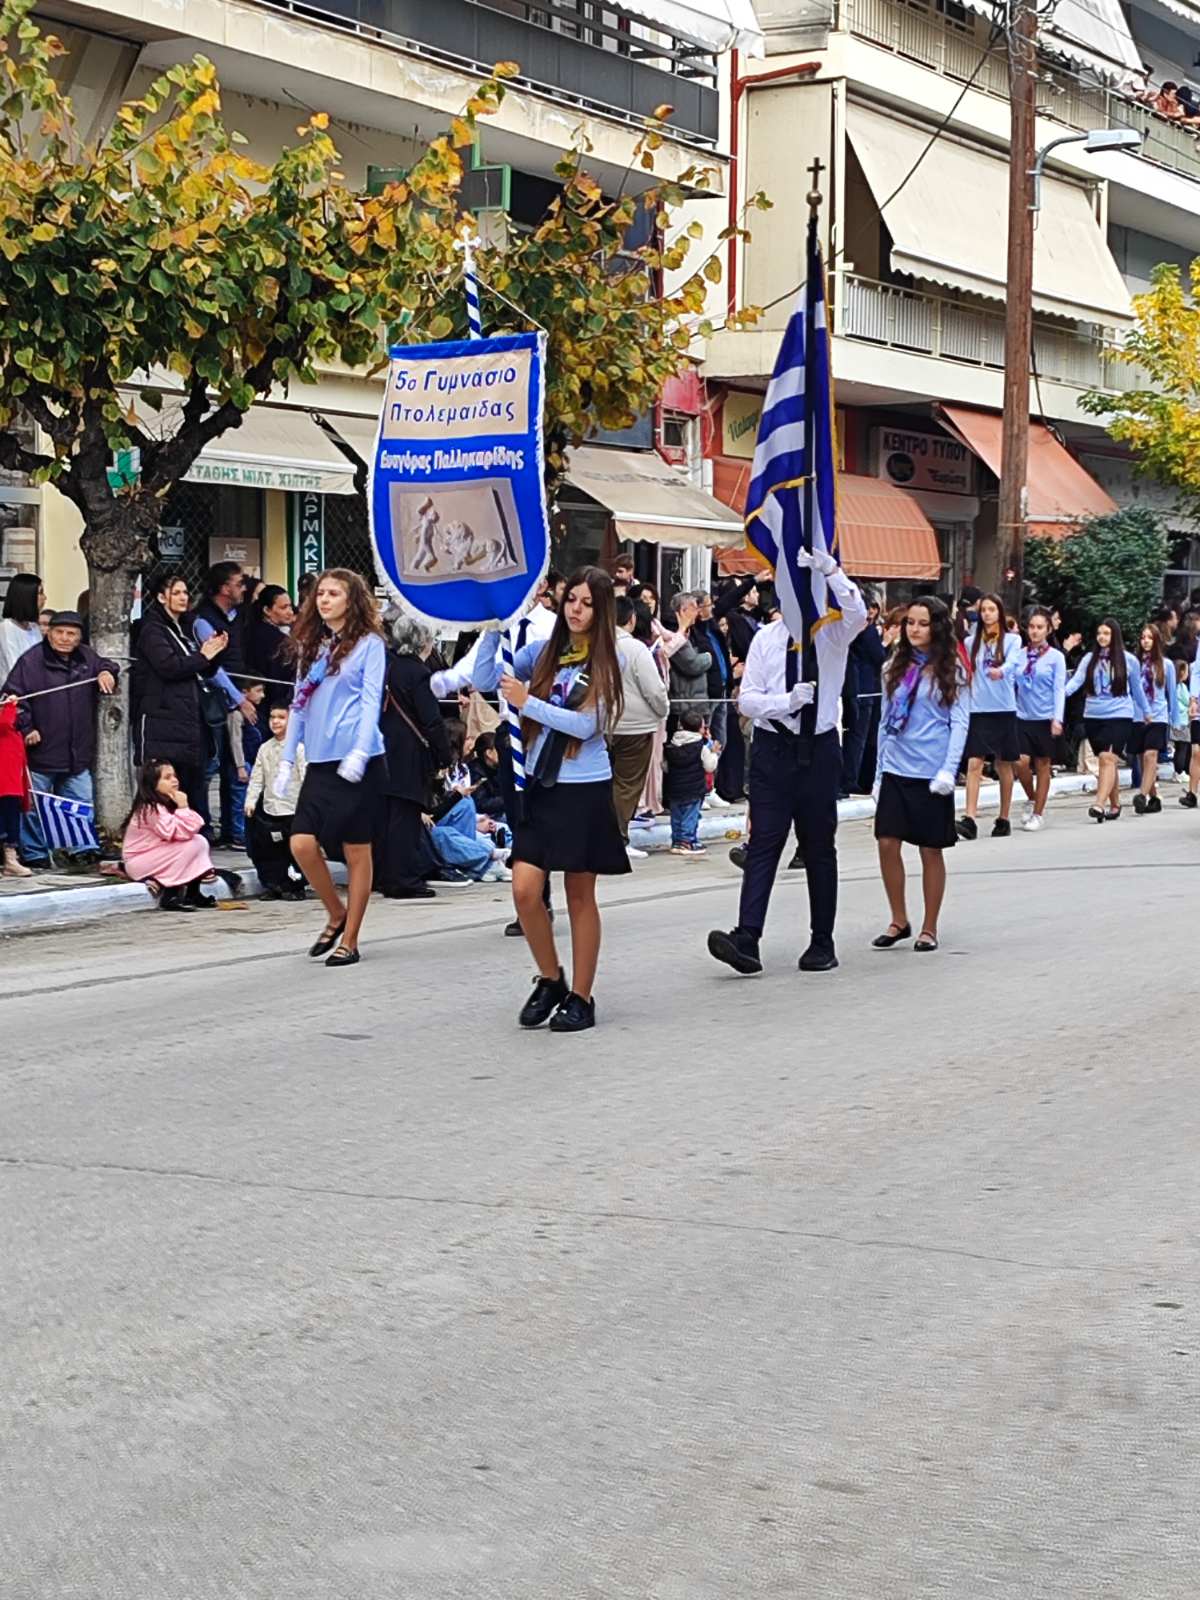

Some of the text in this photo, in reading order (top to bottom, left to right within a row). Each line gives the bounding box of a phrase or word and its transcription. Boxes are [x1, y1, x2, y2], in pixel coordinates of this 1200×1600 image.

[423, 367, 517, 395] Γυμνάσιο
[883, 431, 968, 461] ΚΕΝΤΡΟ ΤΥΠΟΥ
